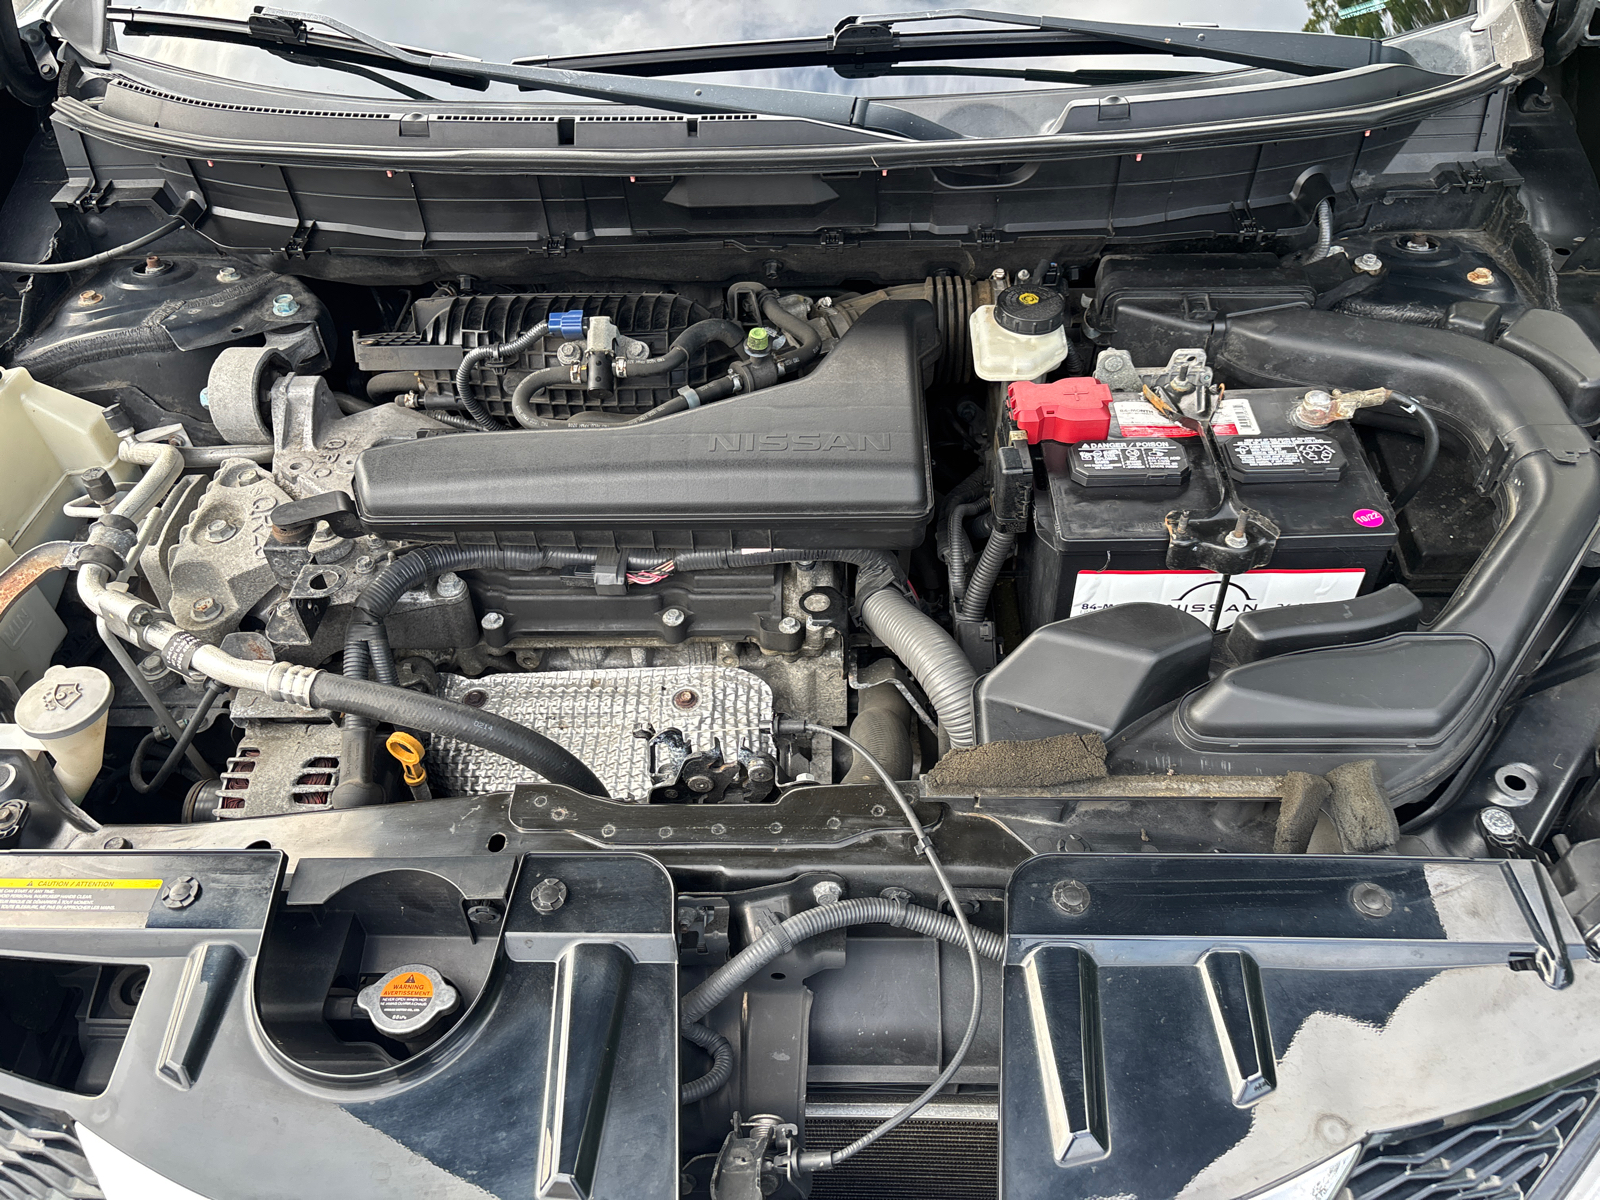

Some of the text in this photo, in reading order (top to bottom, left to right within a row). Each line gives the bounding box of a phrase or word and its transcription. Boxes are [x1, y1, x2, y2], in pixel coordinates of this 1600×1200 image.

[708, 432, 892, 452] NISSAN
[1356, 512, 1381, 523] 10/22
[1177, 603, 1258, 612] ISSAN
[3, 607, 30, 642] MIN
